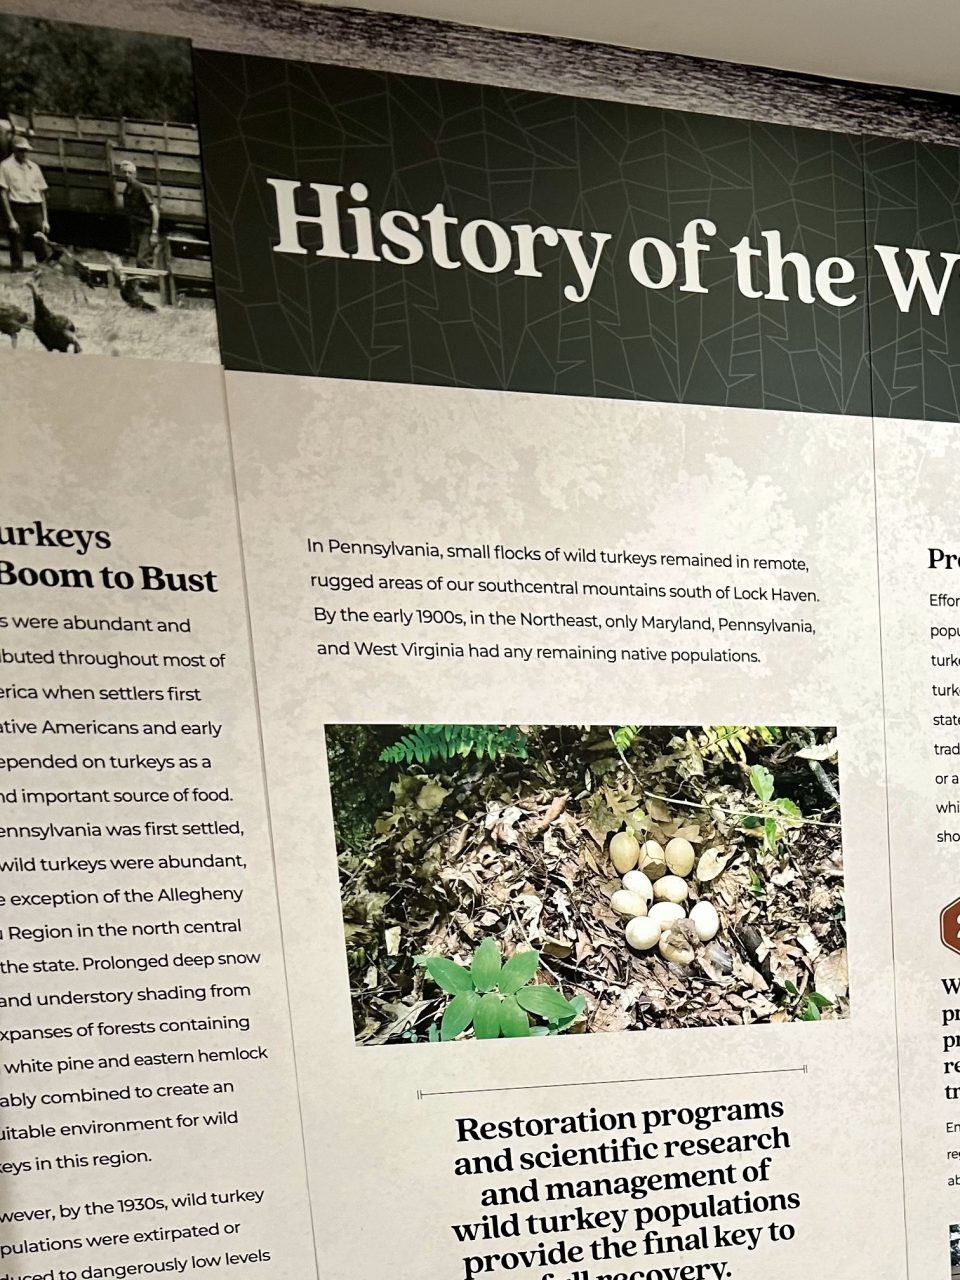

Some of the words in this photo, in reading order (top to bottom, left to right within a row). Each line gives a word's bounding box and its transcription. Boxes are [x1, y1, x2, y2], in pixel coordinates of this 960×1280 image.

[266, 178, 612, 303] History
[629, 218, 717, 294] of
[730, 230, 858, 308] the
[0, 560, 95, 588] Boom
[99, 567, 134, 590] to
[138, 566, 218, 592] Bust
[307, 538, 324, 553] In
[328, 539, 443, 560] Pennsylvania,
[447, 544, 490, 559] small
[494, 545, 541, 561] flocks
[545, 547, 561, 561] of
[563, 548, 596, 563] wild
[600, 550, 657, 568] turkeys
[661, 553, 732, 568] remained
[736, 554, 749, 568] in
[753, 558, 809, 573] remote,
[317, 641, 350, 655] and
[353, 641, 398, 656] West
[401, 642, 464, 660] Virginia
[468, 643, 499, 658] had
[504, 647, 533, 662] any
[537, 645, 617, 663] remaining
[621, 647, 667, 661] native
[671, 648, 761, 664] populations.
[455, 1107, 637, 1142] Restoration
[641, 1101, 784, 1134] programs
[455, 1147, 514, 1176] and
[520, 1137, 659, 1170] scientific
[664, 1126, 790, 1158] research
[481, 1171, 540, 1206] and
[545, 1164, 737, 1201] management
[742, 1157, 772, 1182] of
[451, 1213, 521, 1242] wild
[525, 1207, 629, 1235] turkey
[634, 1190, 800, 1231] populations
[462, 1241, 584, 1280] provide
[589, 1236, 638, 1260] the
[642, 1226, 709, 1255] final
[713, 1225, 763, 1250] key
[768, 1222, 795, 1241] to
